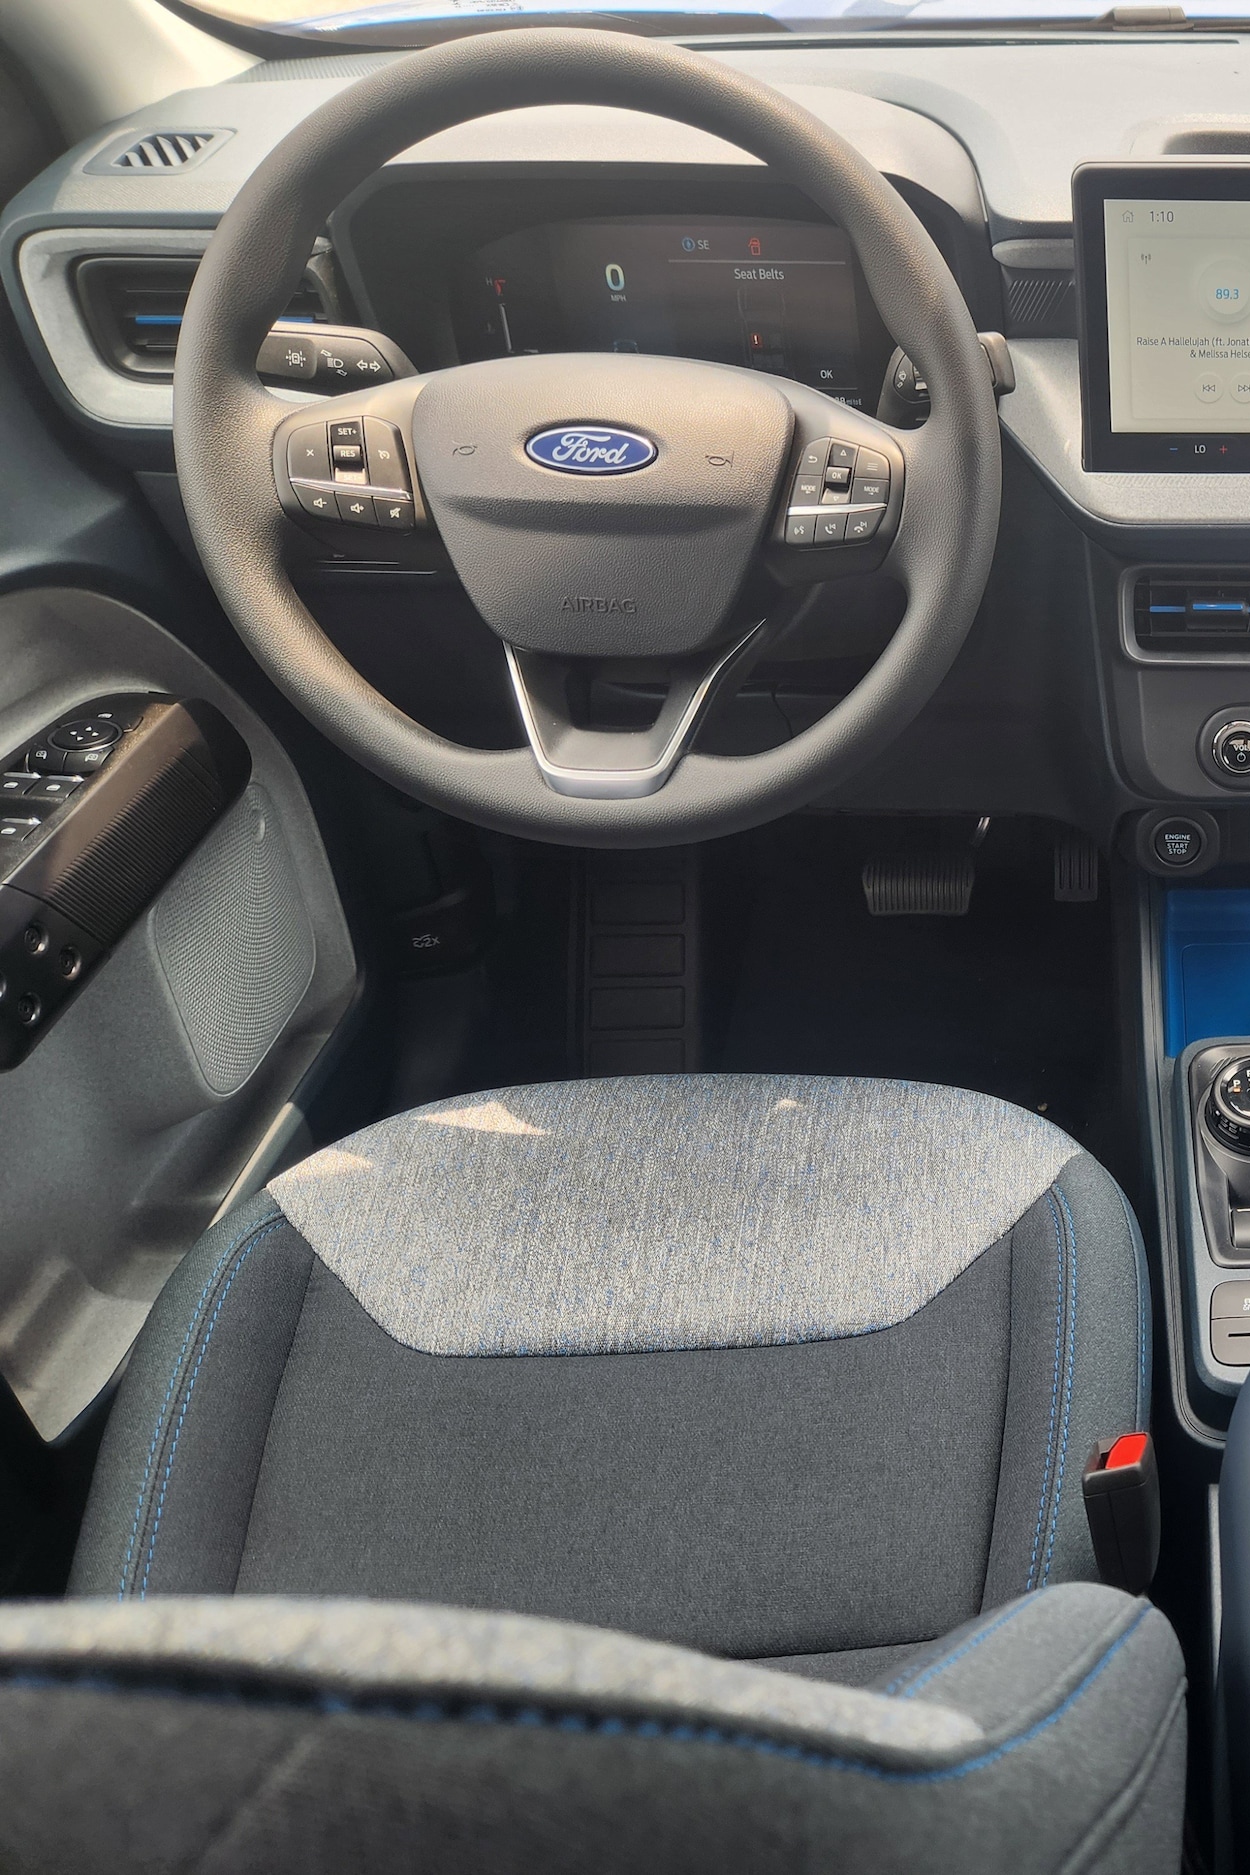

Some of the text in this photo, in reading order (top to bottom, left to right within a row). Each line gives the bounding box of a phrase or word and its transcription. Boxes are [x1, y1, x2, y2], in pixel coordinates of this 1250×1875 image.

[1150, 211, 1174, 223] 1:10
[697, 240, 710, 250] SE
[605, 263, 625, 291] 0
[734, 268, 784, 280] Seat Belts
[611, 294, 627, 302] MPH
[1215, 288, 1239, 300] 89.3
[1136, 337, 1159, 346] Raise
[1160, 337, 1167, 346] A
[1169, 337, 1210, 347] Hallelujah
[1212, 337, 1225, 347] (ft.
[1190, 350, 1197, 358] &
[1199, 349, 1229, 359] Melissa
[820, 369, 833, 379] OK
[337, 427, 357, 435] SET+
[552, 432, 629, 464] Ford
[1194, 445, 1206, 454] LO
[340, 450, 356, 458] RES
[561, 597, 636, 613] AIRBAG
[1233, 744, 1250, 752] VOL
